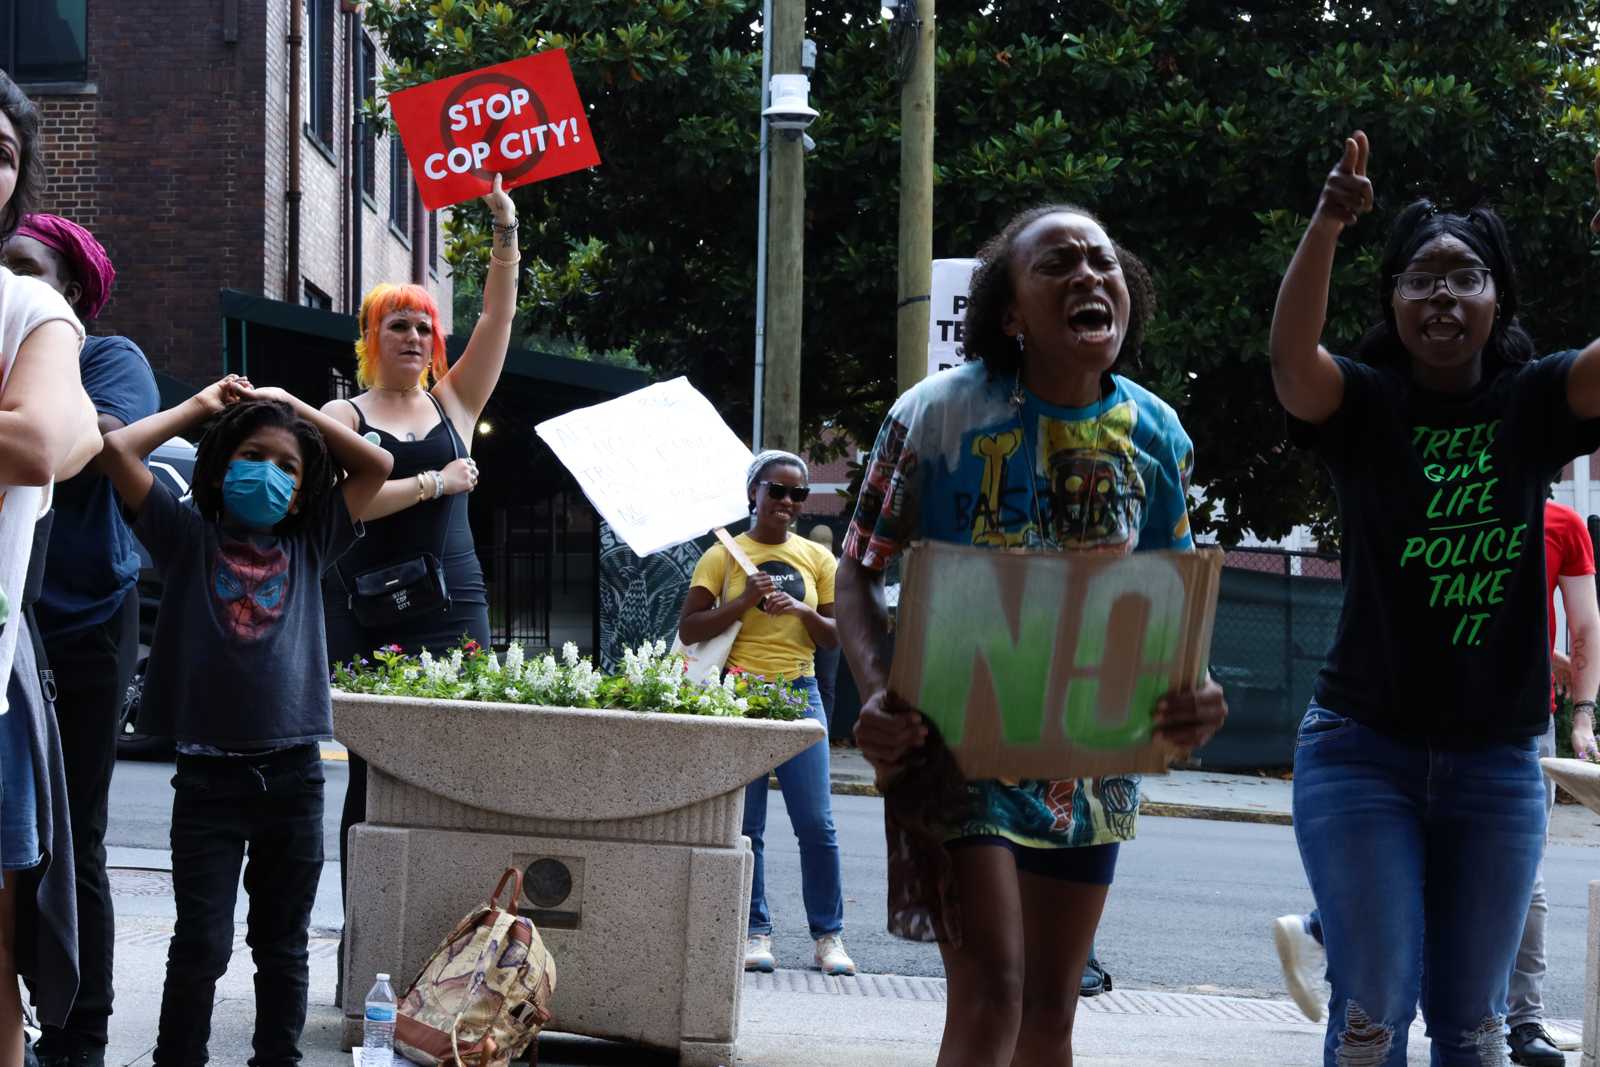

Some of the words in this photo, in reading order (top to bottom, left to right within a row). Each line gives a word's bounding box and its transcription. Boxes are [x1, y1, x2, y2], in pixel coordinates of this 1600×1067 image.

[448, 88, 530, 131] STOP
[424, 141, 490, 180] COP
[500, 117, 581, 159] CITY!
[655, 433, 714, 464] FUND
[598, 481, 620, 498] IS
[1426, 478, 1499, 519] LIFE
[1400, 523, 1528, 568] POLICE
[393, 589, 407, 598] STOP
[396, 596, 407, 604] COP
[397, 601, 410, 610] CITY
[1429, 568, 1512, 608] TAKE
[1452, 613, 1491, 645] IT.
[916, 554, 1186, 750] NO
